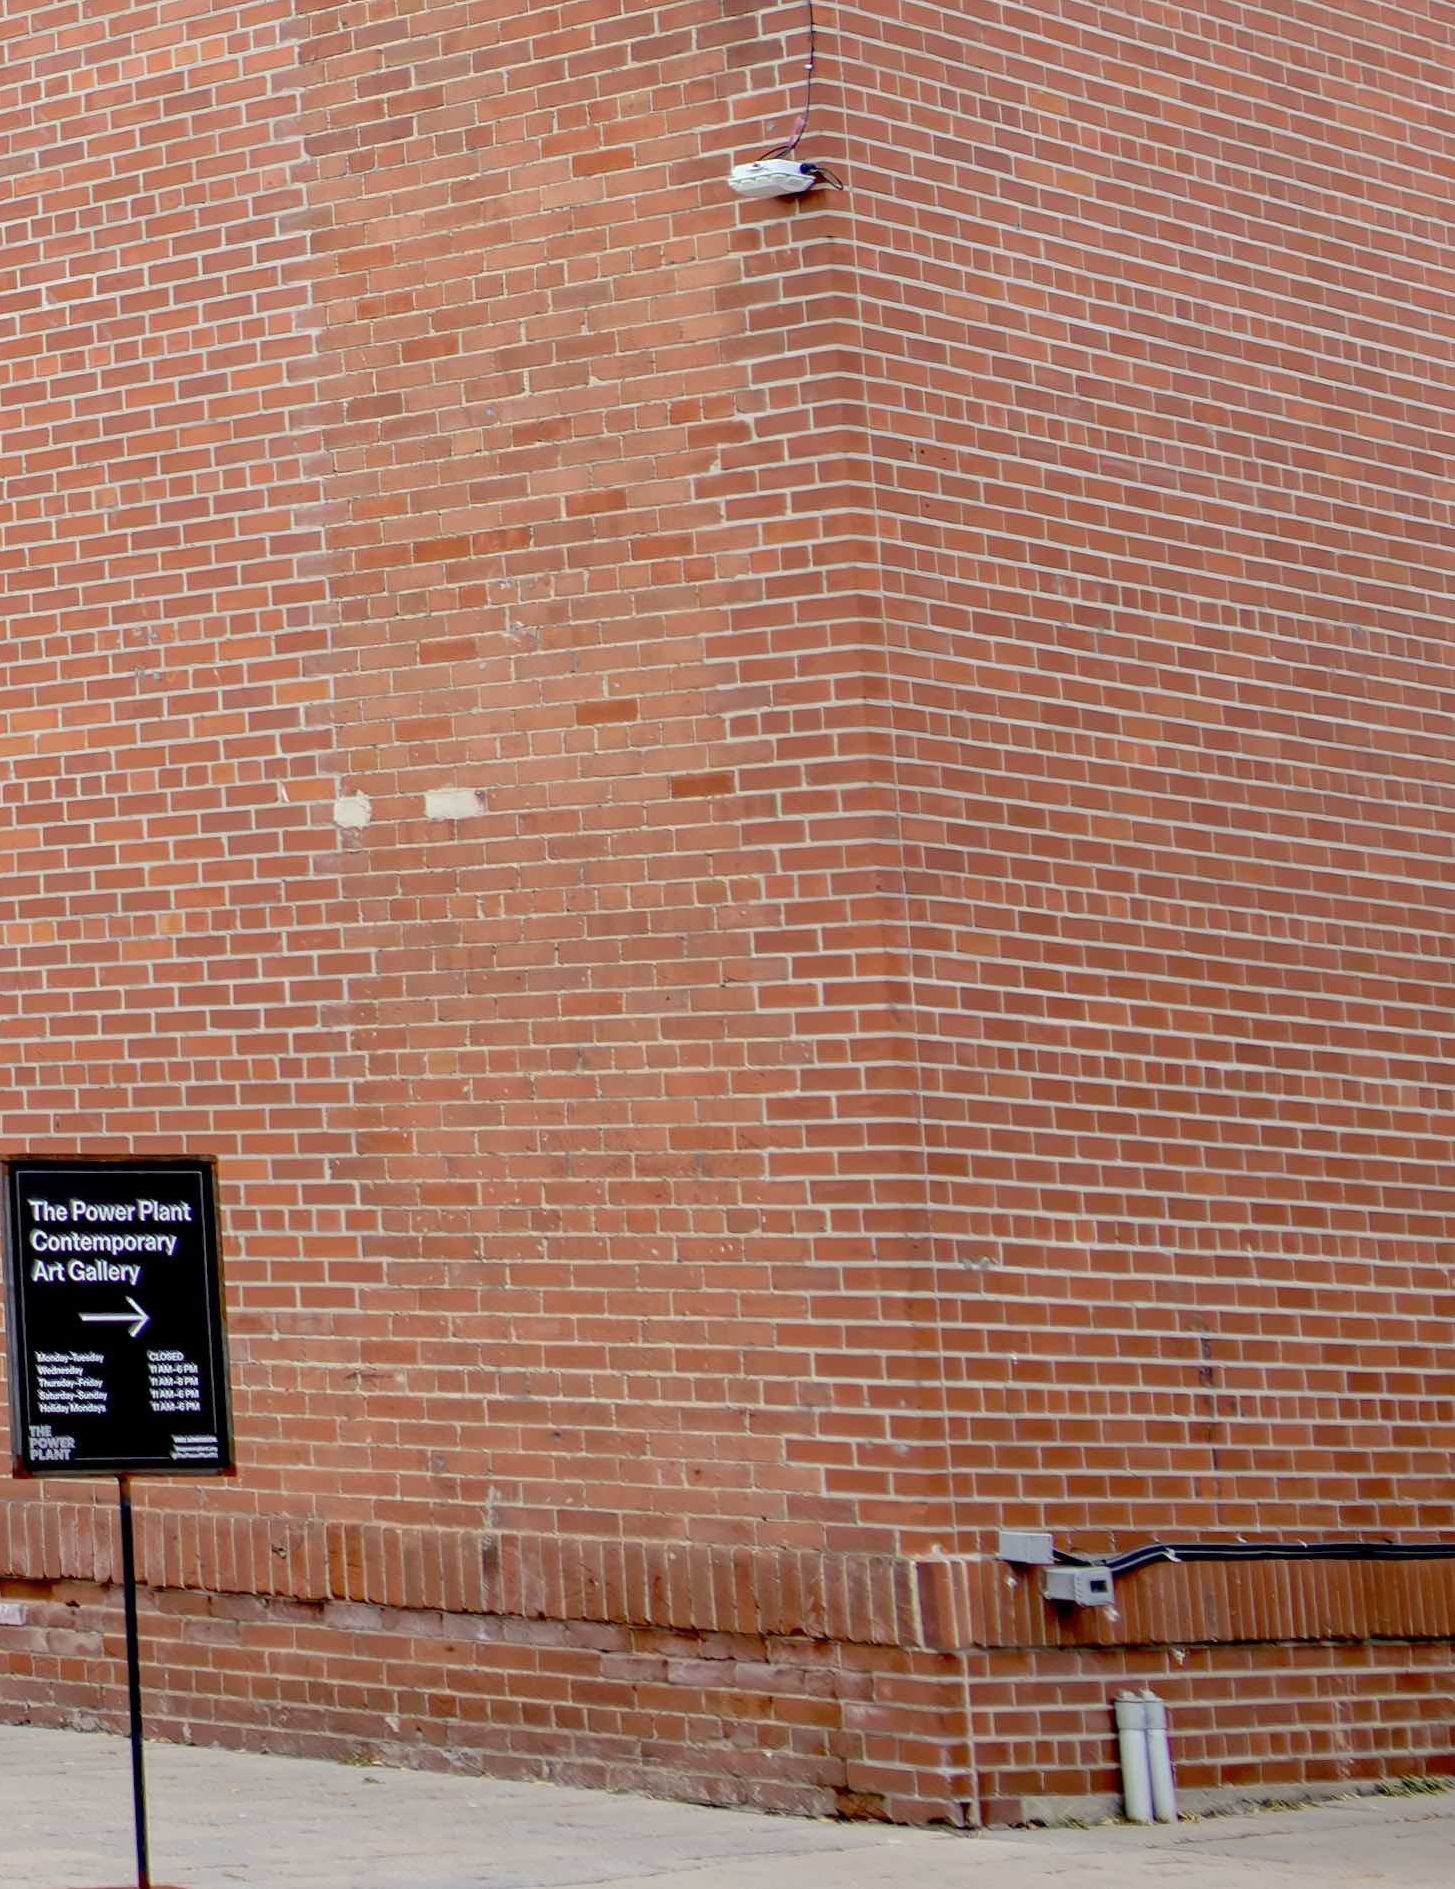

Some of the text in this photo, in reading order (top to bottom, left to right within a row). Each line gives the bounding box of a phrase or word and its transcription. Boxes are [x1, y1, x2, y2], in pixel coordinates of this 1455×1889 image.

[29, 1199, 192, 1223] The Power Plant
[30, 1230, 177, 1256] Contemporary
[31, 1259, 140, 1286] Art Gallery
[146, 1350, 184, 1362] CLOSED
[184, 1362, 199, 1374] PM
[184, 1375, 199, 1386] PM
[185, 1388, 200, 1399] PM
[186, 1400, 201, 1411] PM
[29, 1425, 52, 1438] THE
[29, 1436, 76, 1449] POWER
[29, 1449, 72, 1461] PLANT
